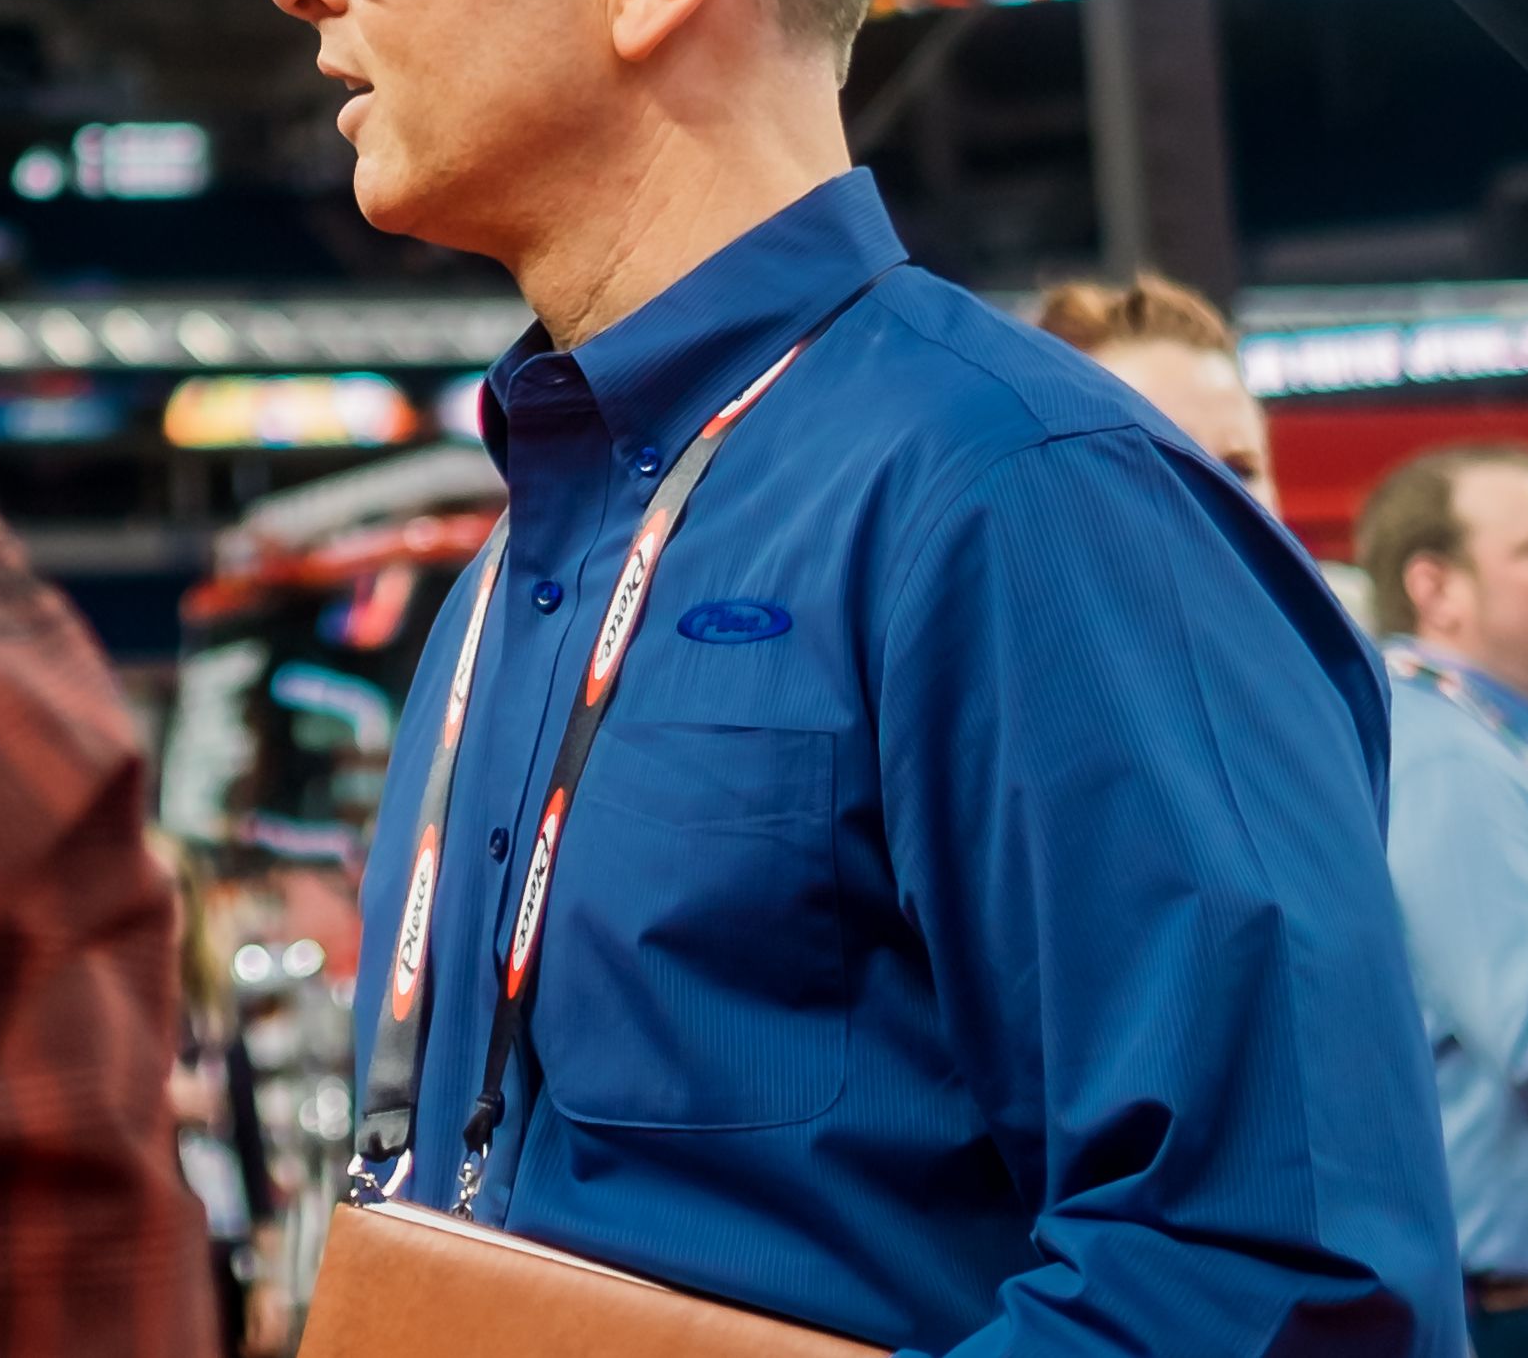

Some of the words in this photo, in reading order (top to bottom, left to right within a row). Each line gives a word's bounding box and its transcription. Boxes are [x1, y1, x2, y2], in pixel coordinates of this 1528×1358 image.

[597, 549, 647, 662] Pierce
[398, 864, 430, 976] Pierce
[515, 831, 552, 953] Pierce
